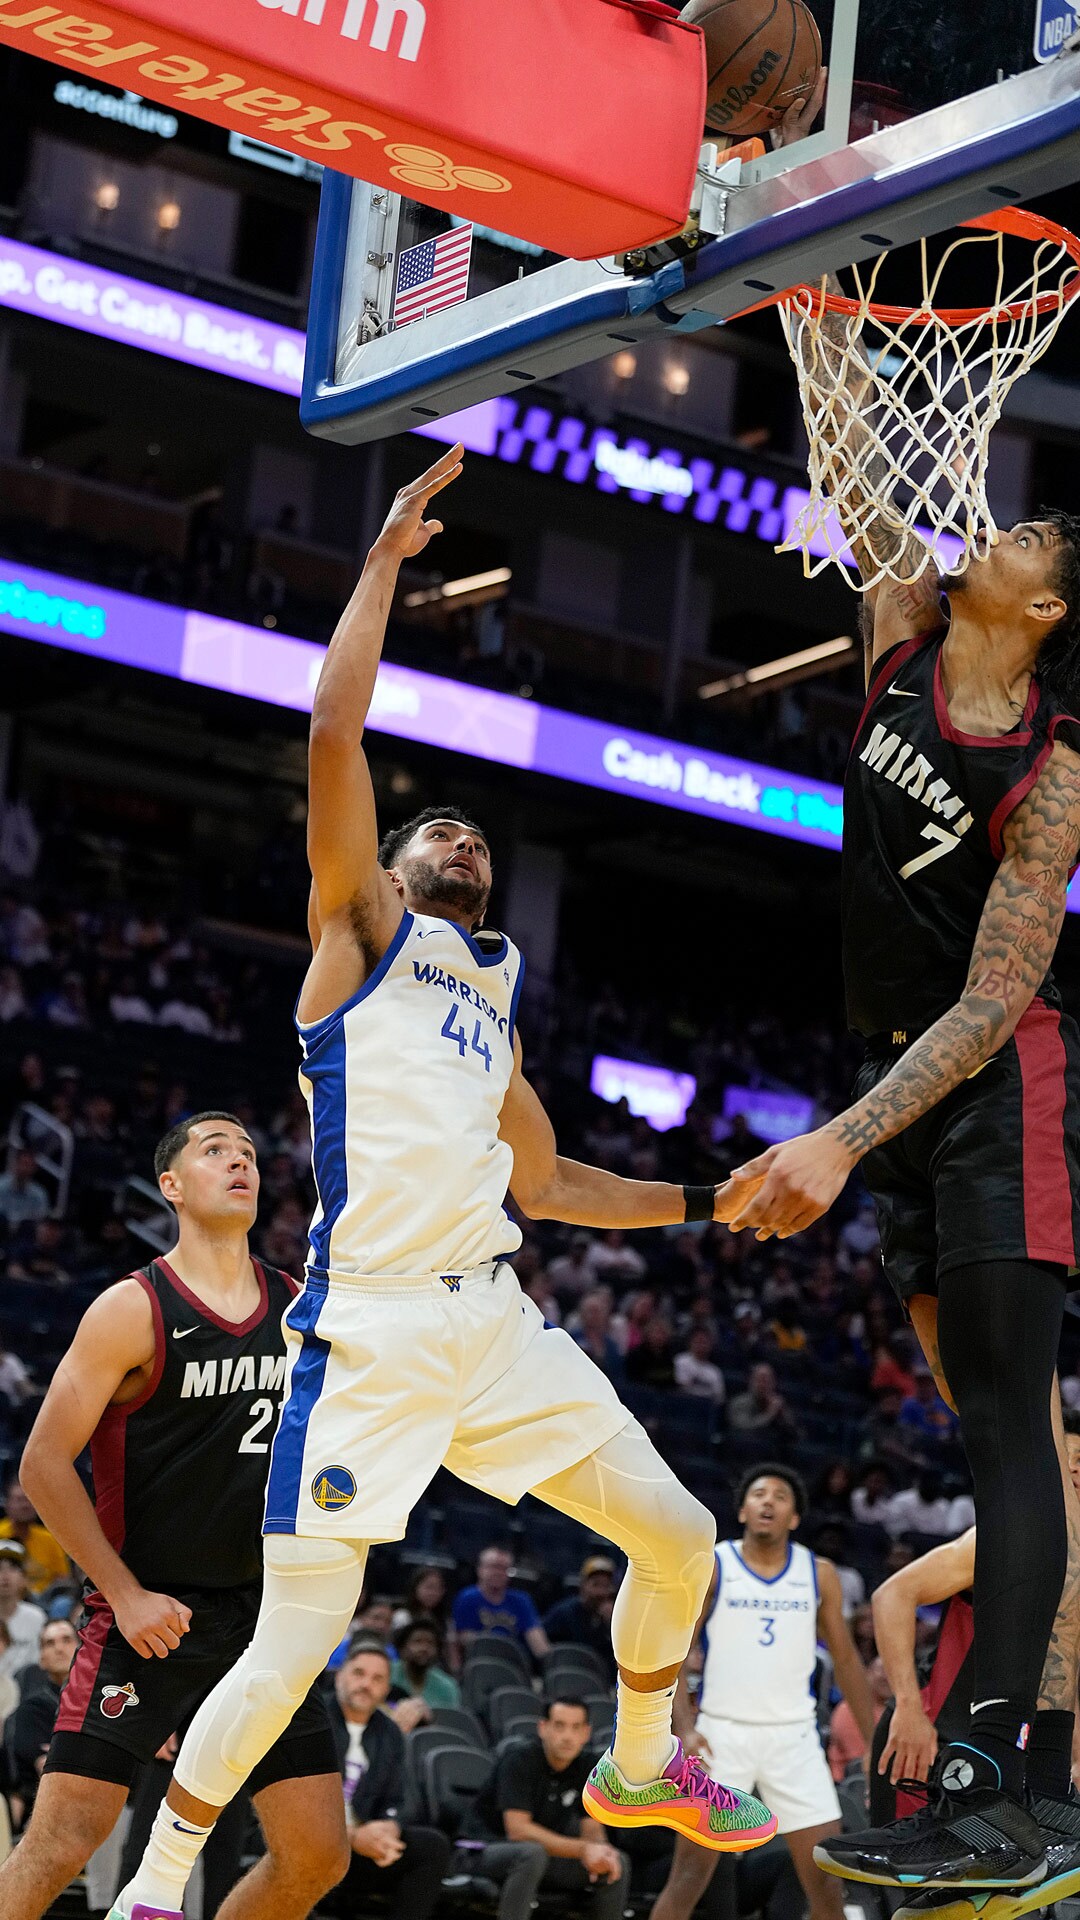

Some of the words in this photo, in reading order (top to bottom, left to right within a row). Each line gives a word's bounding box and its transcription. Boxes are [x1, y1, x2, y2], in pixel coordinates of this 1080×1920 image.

[0, 0, 160, 68] Far
[1042, 13, 1073, 51] NBA
[705, 49, 782, 125] Wilson
[35, 266, 99, 316] Get
[100, 286, 182, 342] Cash
[183, 312, 271, 371] Back.
[602, 738, 684, 793] Cash
[683, 758, 761, 814] Back
[759, 786, 797, 822] at
[859, 723, 975, 838] MIAMI
[898, 821, 962, 880] 7
[412, 960, 508, 1035] WARRIORS
[441, 1002, 493, 1073] 44
[908, 1044, 946, 1081] Reason
[877, 1080, 916, 1114] Bad
[180, 1355, 287, 1398] MIAM
[238, 1398, 286, 1453] 2
[726, 1599, 810, 1612] WARRIORS
[758, 1617, 776, 1646] 3
